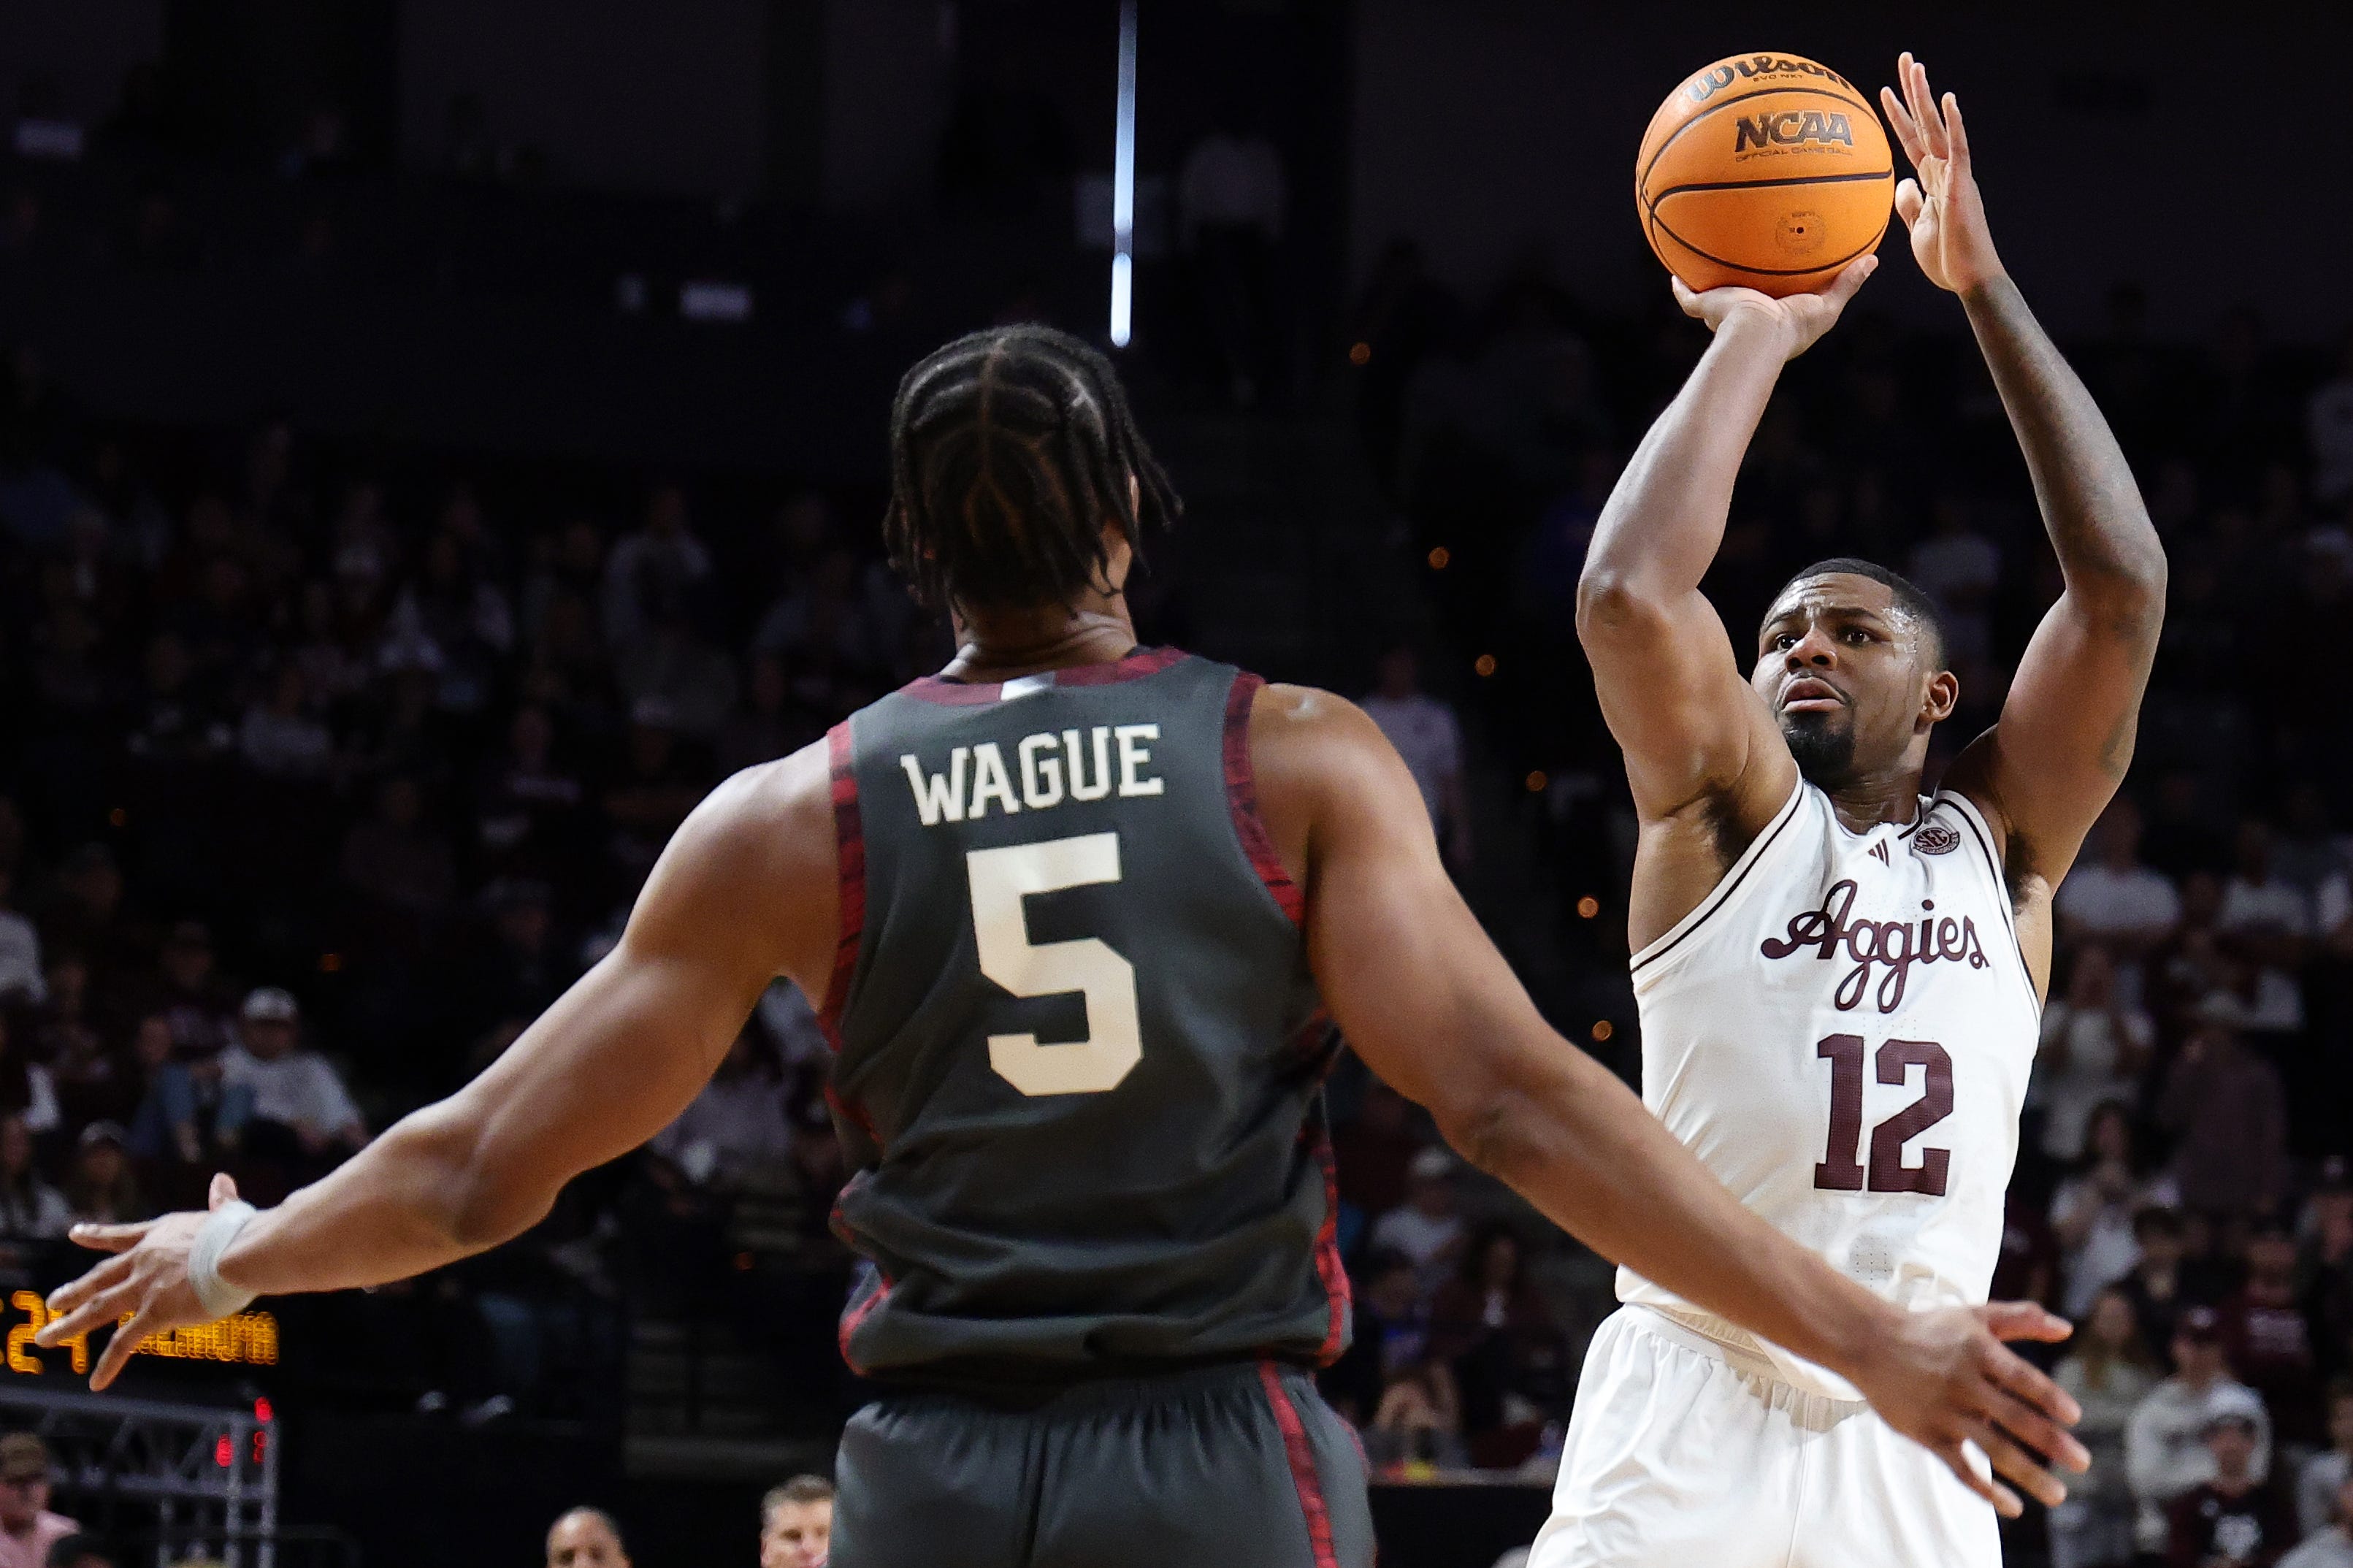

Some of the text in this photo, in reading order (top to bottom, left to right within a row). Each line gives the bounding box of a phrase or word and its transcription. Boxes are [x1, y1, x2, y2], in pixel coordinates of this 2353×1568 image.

[1683, 56, 1853, 101] Wilson
[1735, 110, 1853, 152] NCAA
[900, 724, 1165, 826] WAGUE
[966, 832, 1143, 1096] 5
[1761, 879, 1990, 1013] Aggies
[1814, 1033, 1954, 1197] 12
